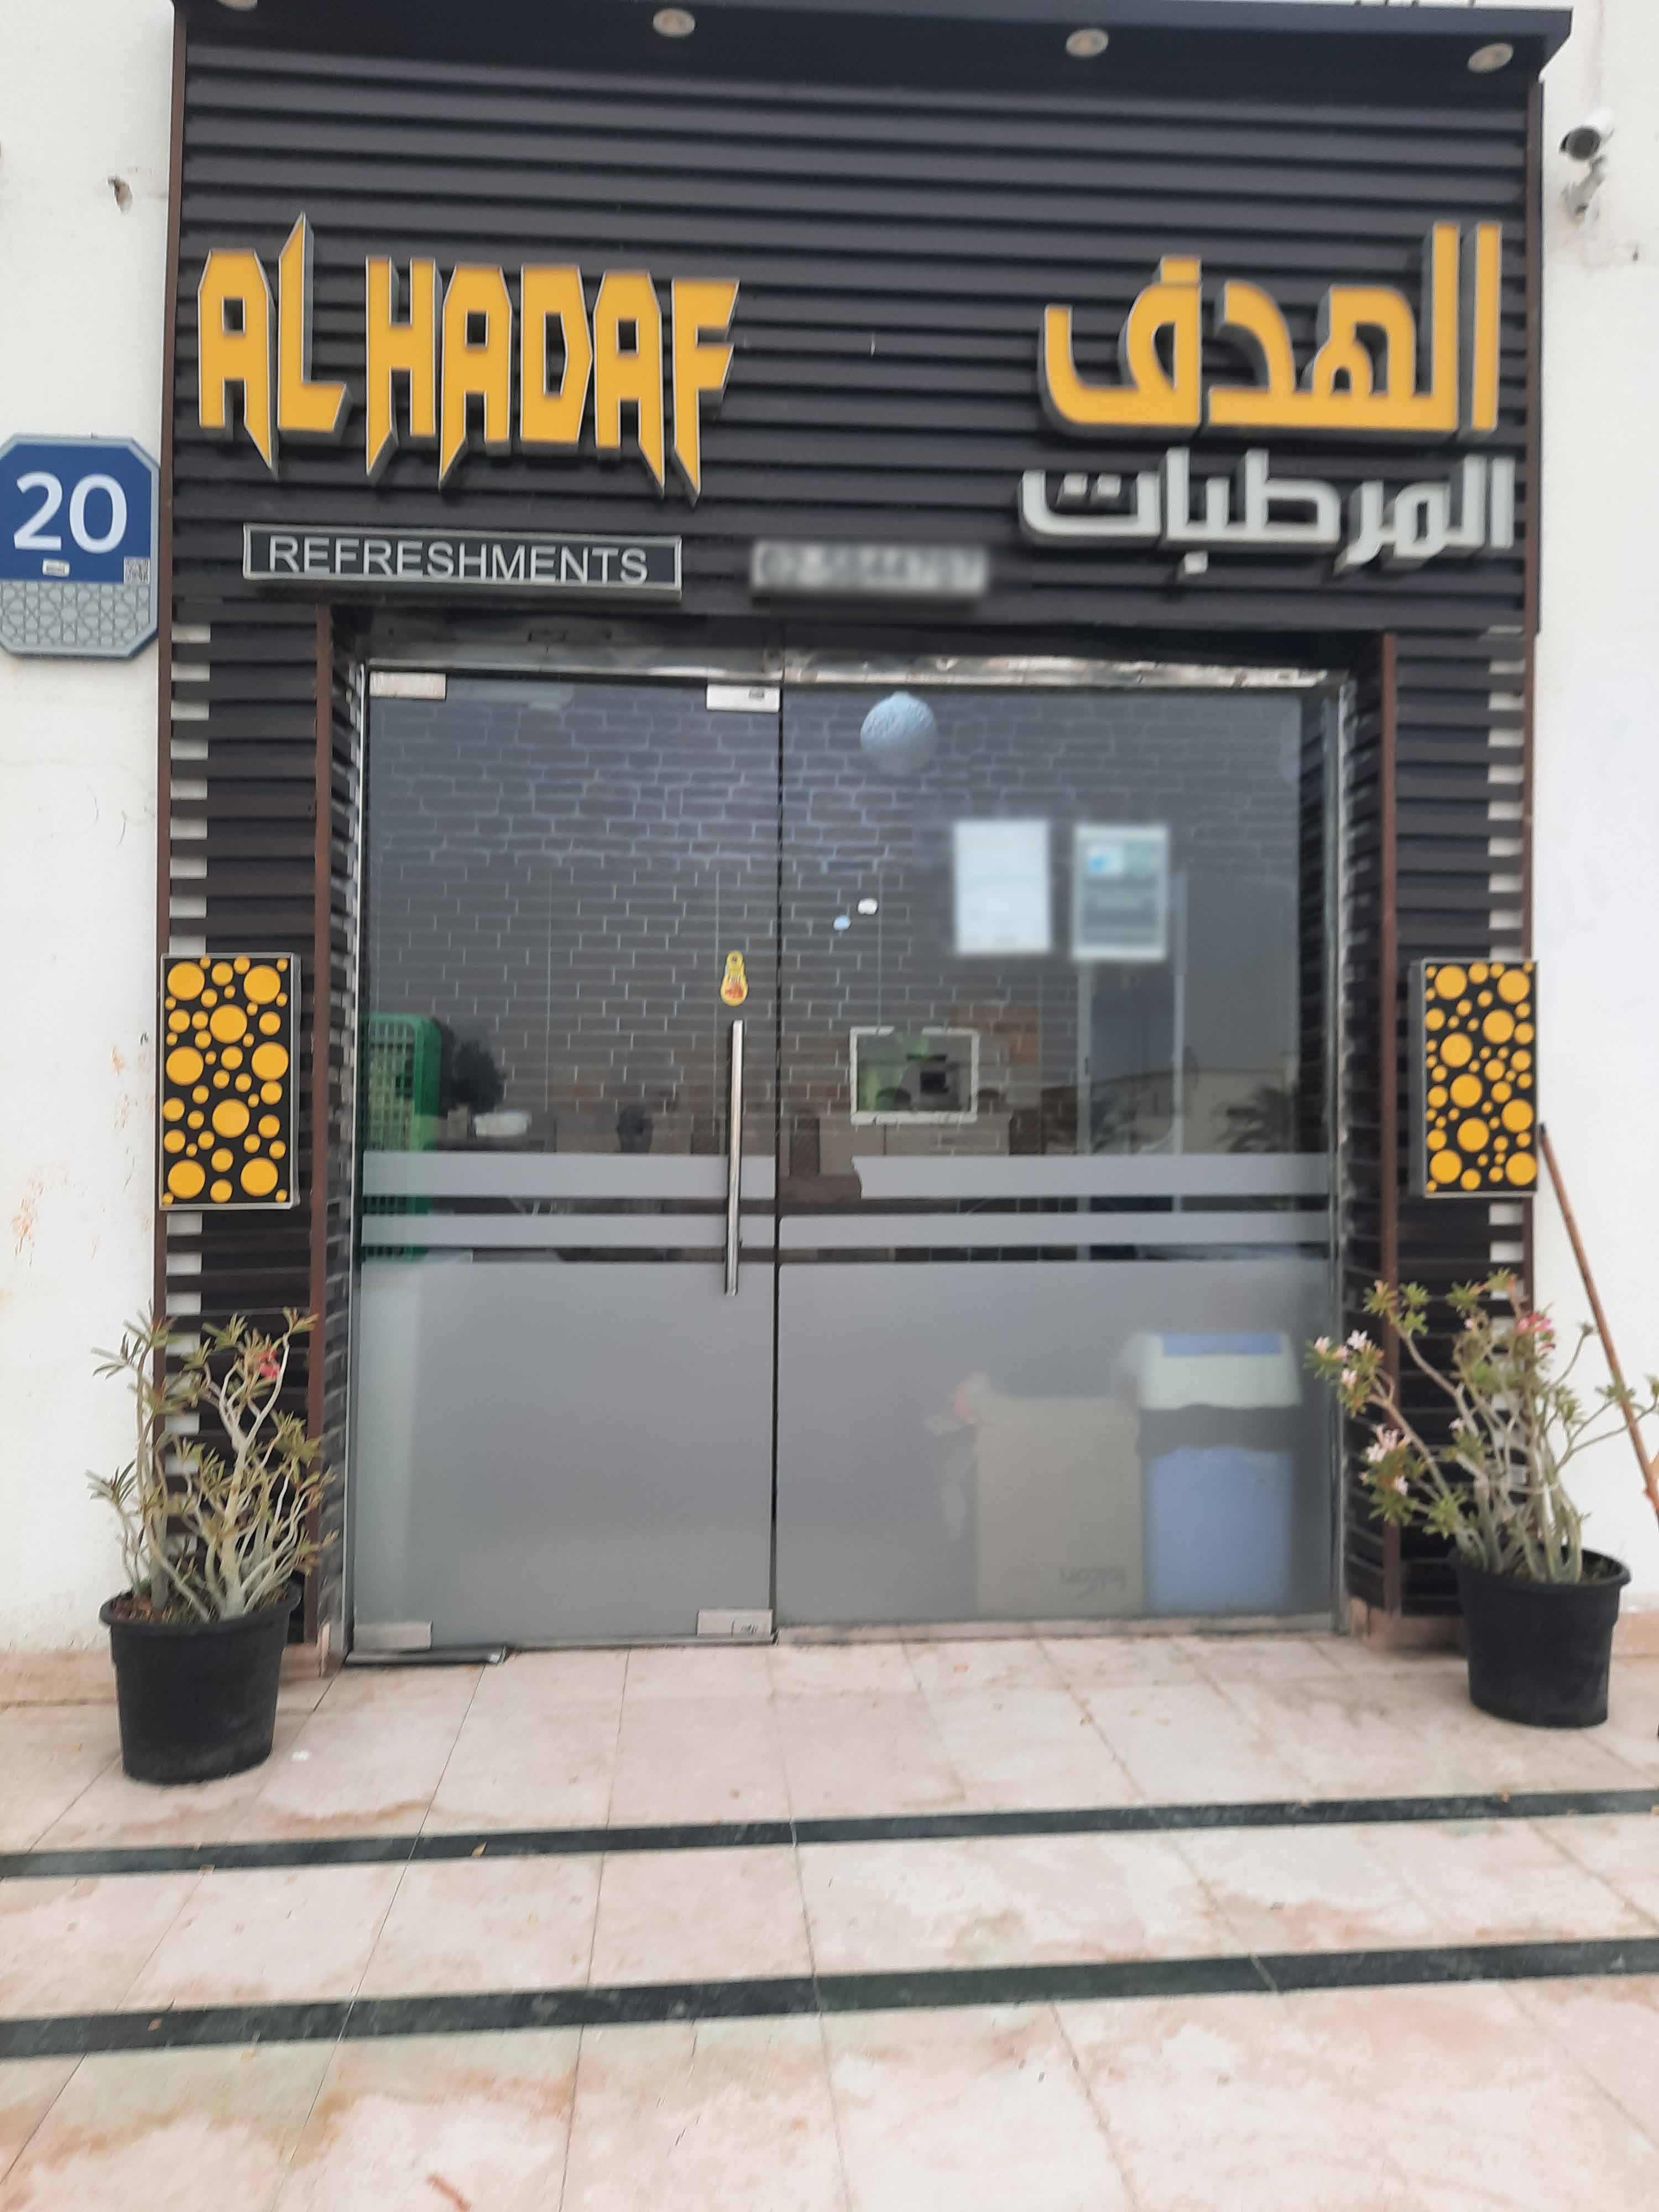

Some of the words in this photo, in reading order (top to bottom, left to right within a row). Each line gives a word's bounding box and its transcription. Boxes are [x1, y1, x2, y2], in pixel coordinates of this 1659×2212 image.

[198, 212, 347, 477] AL
[365, 257, 740, 505] HADAF
[1042, 222, 1501, 431] الهدف
[14, 472, 127, 554] 20
[269, 535, 648, 585] REFRESHMENTS
[1021, 447, 1514, 574] المرطبات
